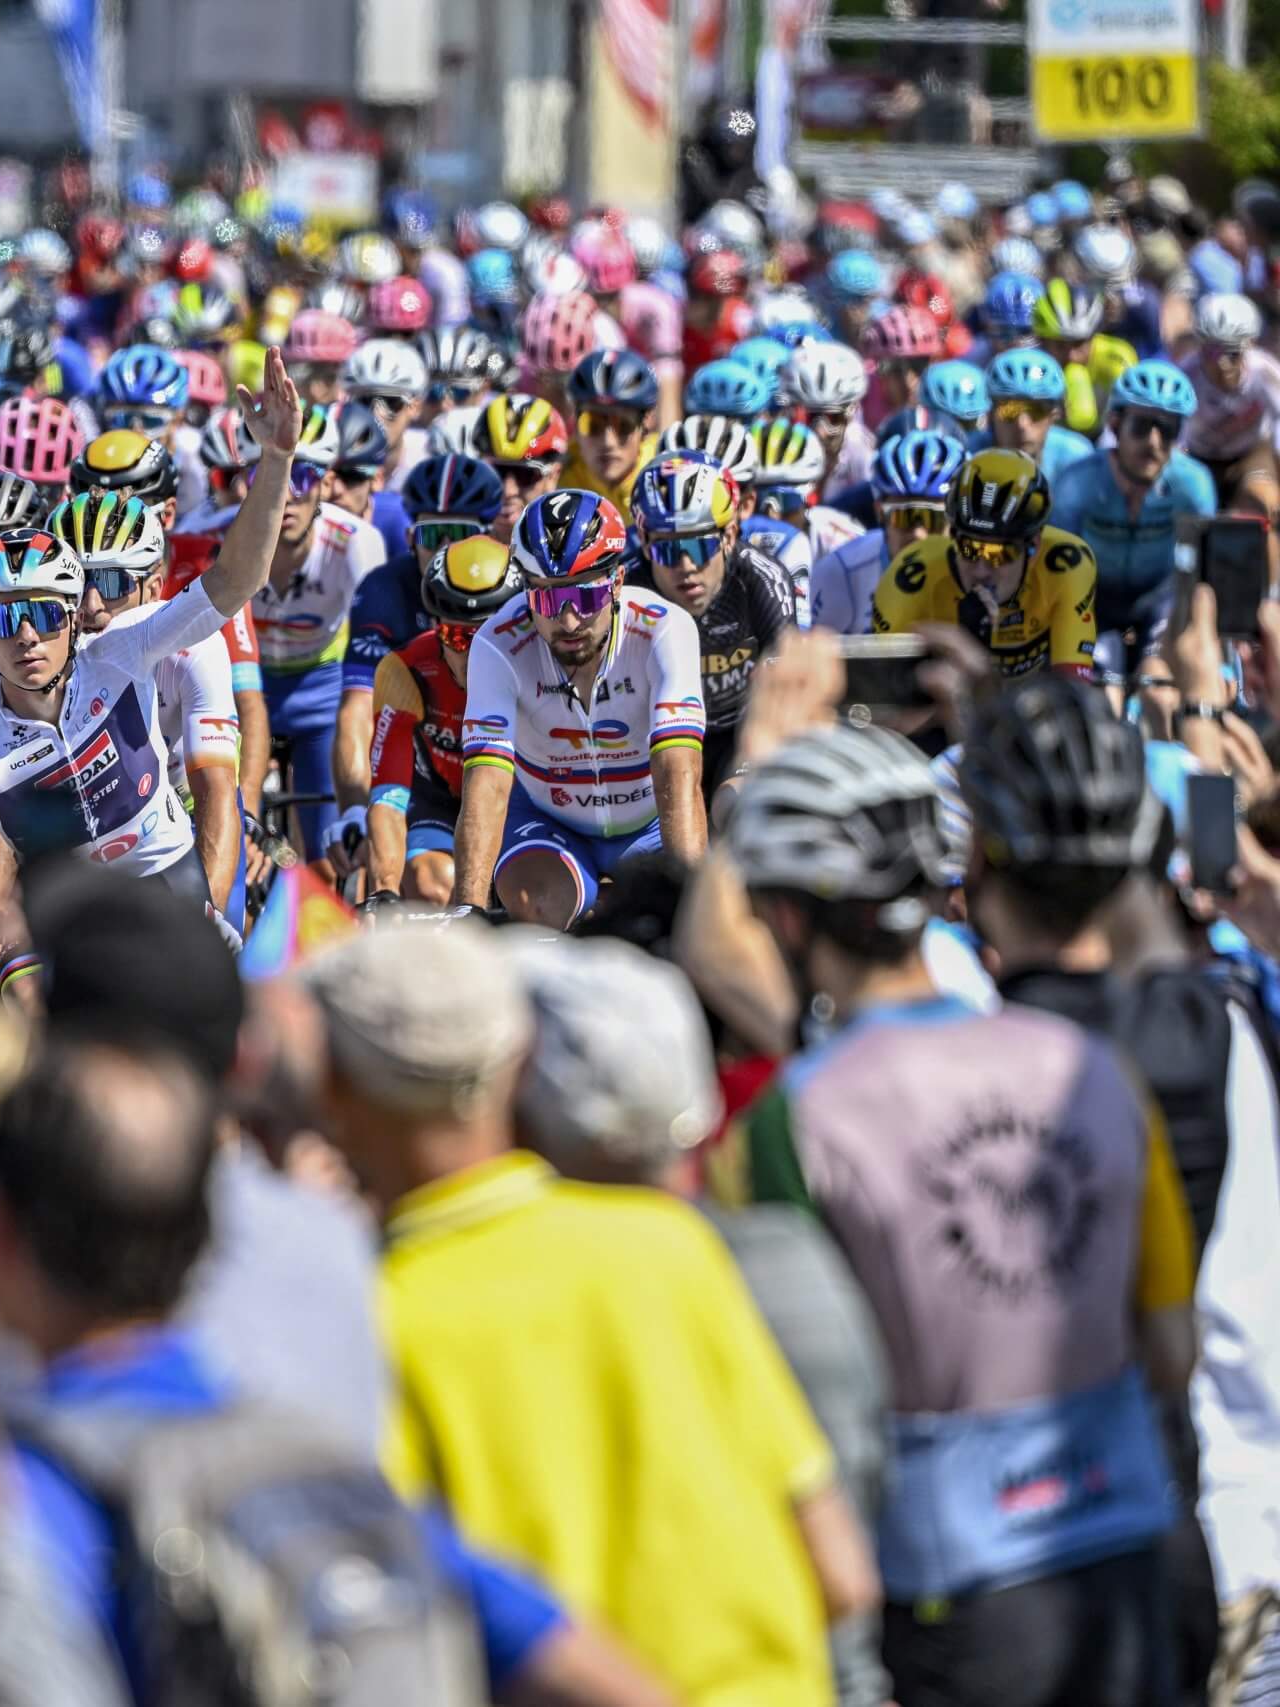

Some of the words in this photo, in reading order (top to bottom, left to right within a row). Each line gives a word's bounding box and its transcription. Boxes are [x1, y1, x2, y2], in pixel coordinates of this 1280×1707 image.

[1070, 58, 1171, 118] 100
[10, 761, 26, 770] UCI
[576, 786, 651, 808] VENDÉE
